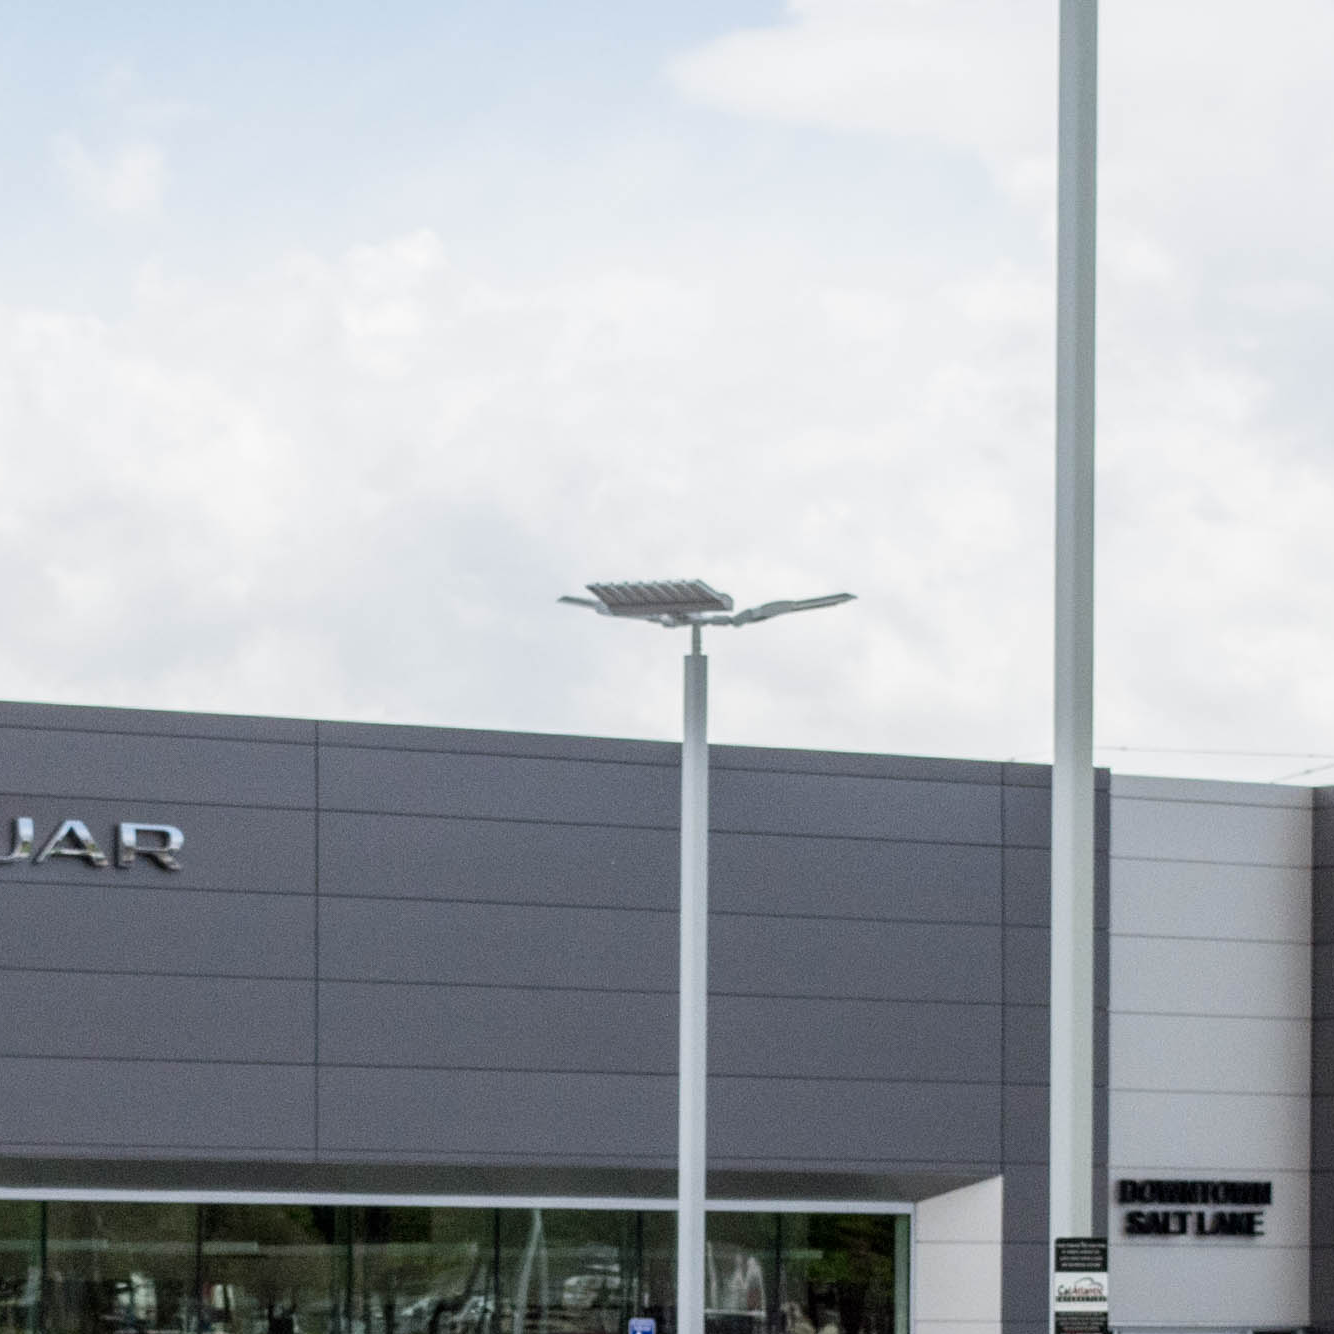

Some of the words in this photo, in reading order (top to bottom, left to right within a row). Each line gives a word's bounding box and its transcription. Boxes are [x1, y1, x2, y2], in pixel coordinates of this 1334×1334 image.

[1116, 1179, 1272, 1205] DOWNTOWN
[1125, 1210, 1192, 1235] SALT
[1195, 1210, 1265, 1236] LAKE
